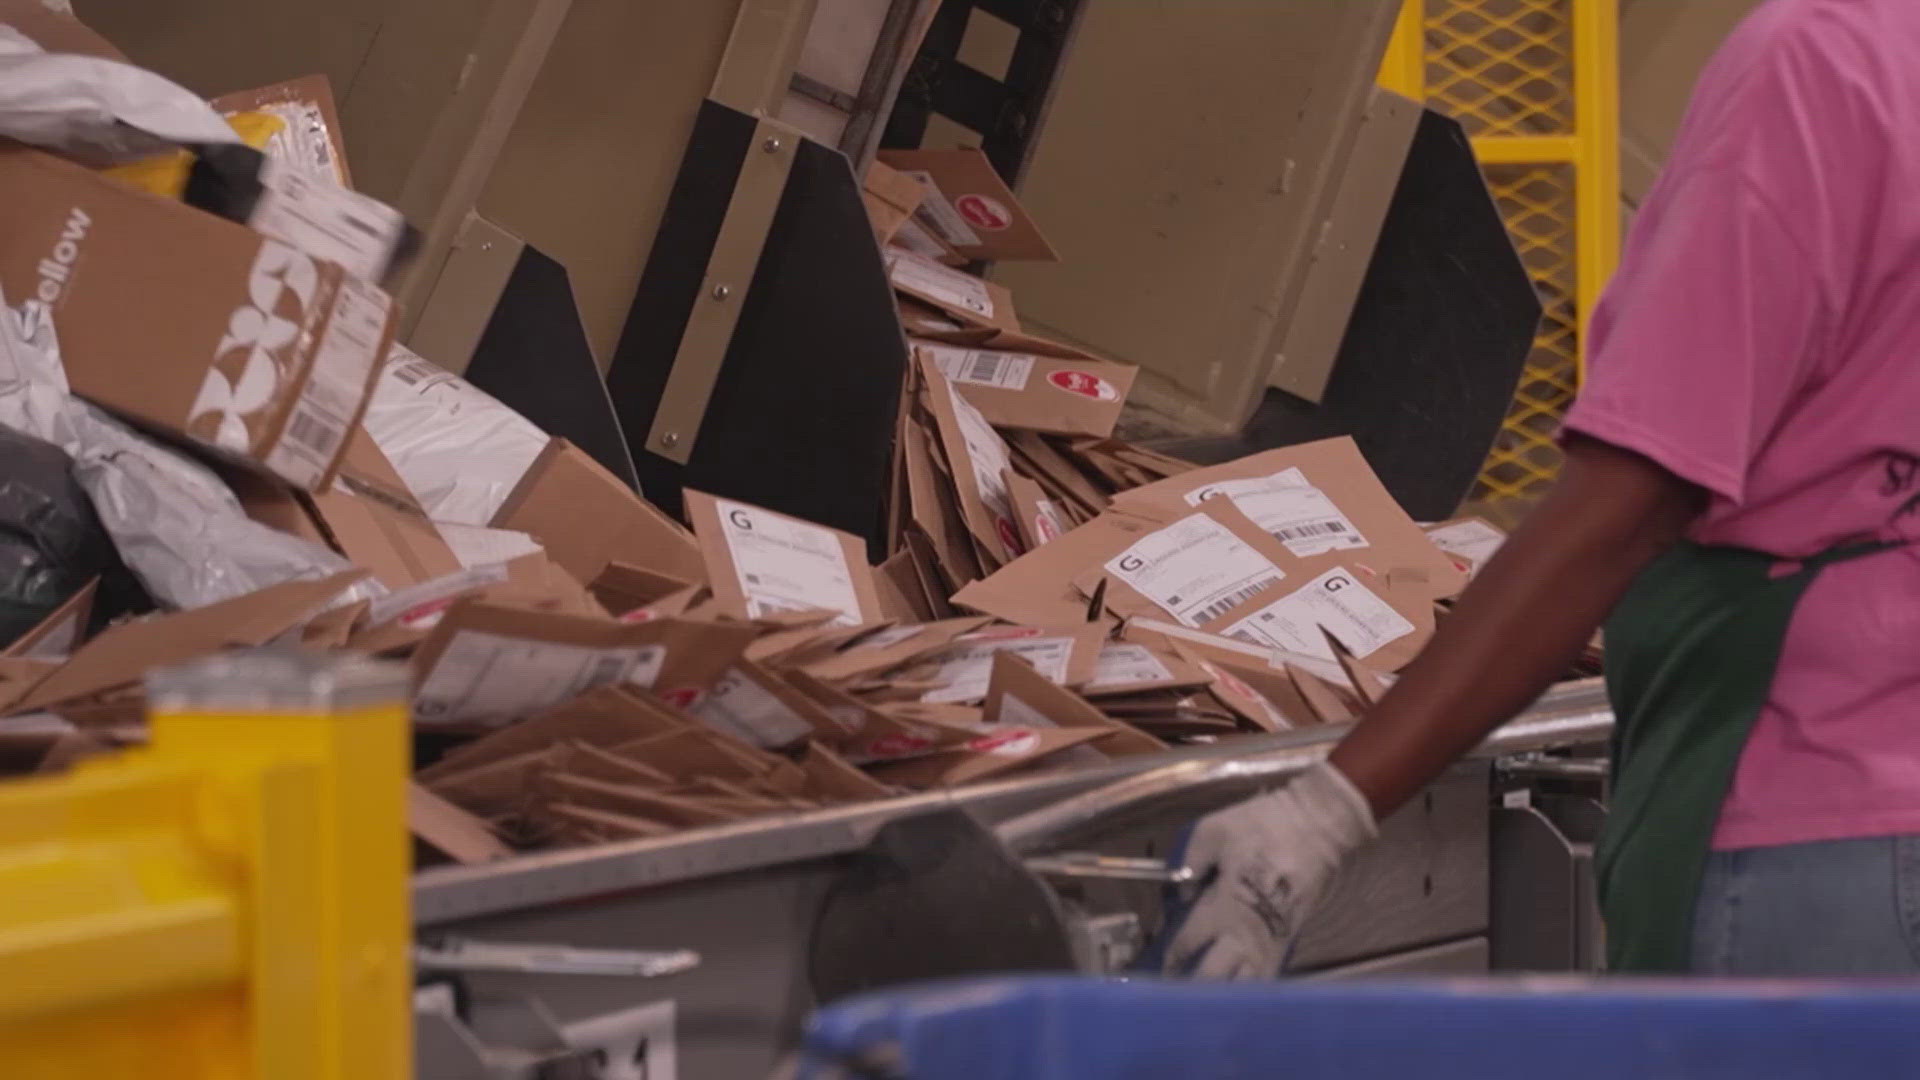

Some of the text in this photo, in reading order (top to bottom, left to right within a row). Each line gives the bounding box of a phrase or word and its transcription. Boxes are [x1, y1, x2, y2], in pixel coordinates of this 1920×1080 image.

[730, 509, 752, 530] G
[1119, 555, 1144, 572] G
[1324, 576, 1350, 592] G
